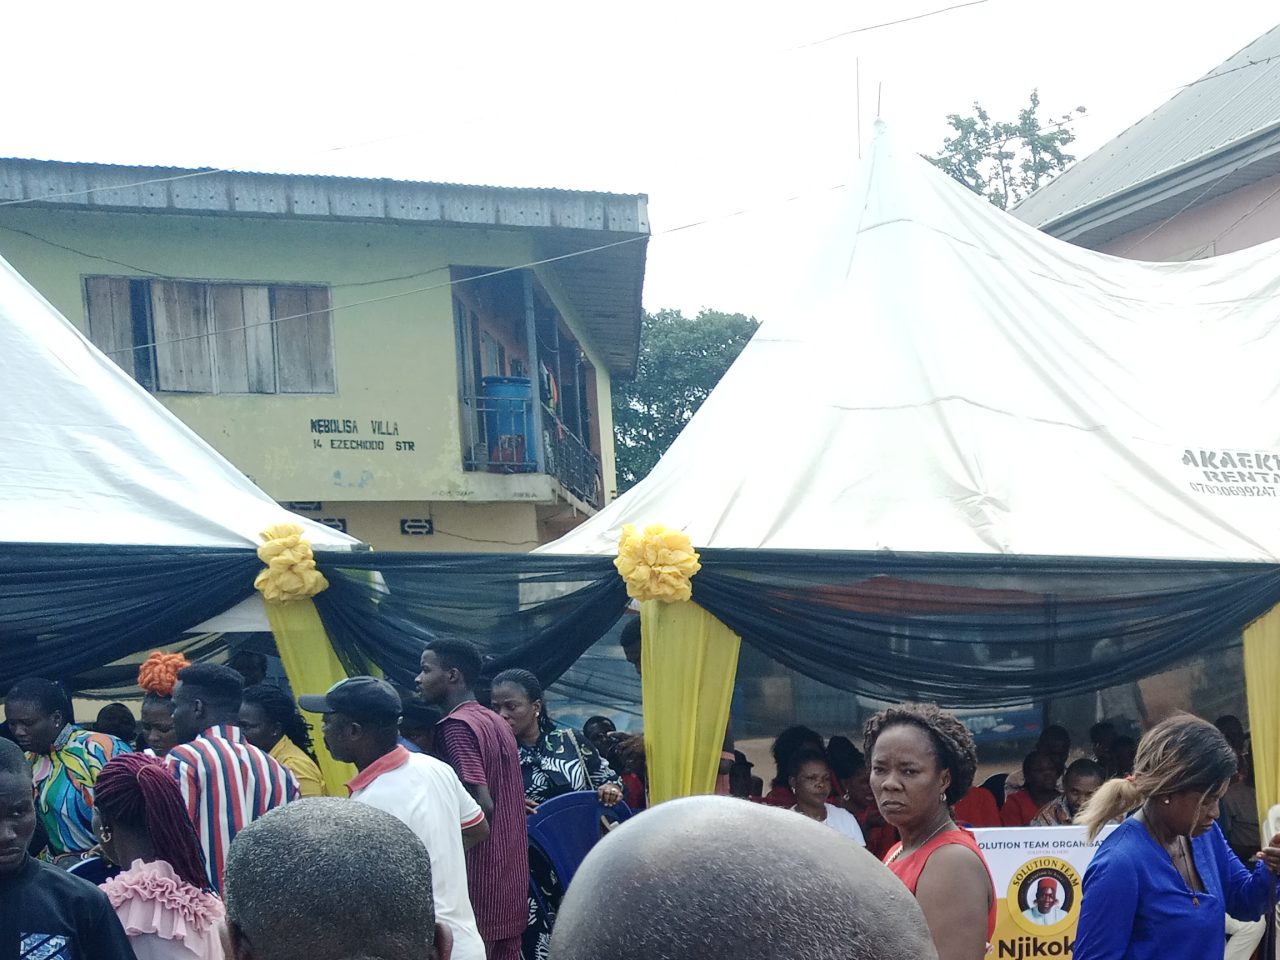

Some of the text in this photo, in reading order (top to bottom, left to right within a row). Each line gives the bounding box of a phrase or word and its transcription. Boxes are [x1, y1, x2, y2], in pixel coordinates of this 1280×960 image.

[370, 420, 399, 436] VILLA
[313, 439, 322, 448] 14
[395, 441, 415, 451] STR
[978, 841, 1021, 850] OLUTION
[1024, 841, 1050, 849] TEAM
[1012, 858, 1080, 887] SOLUTION TEAM
